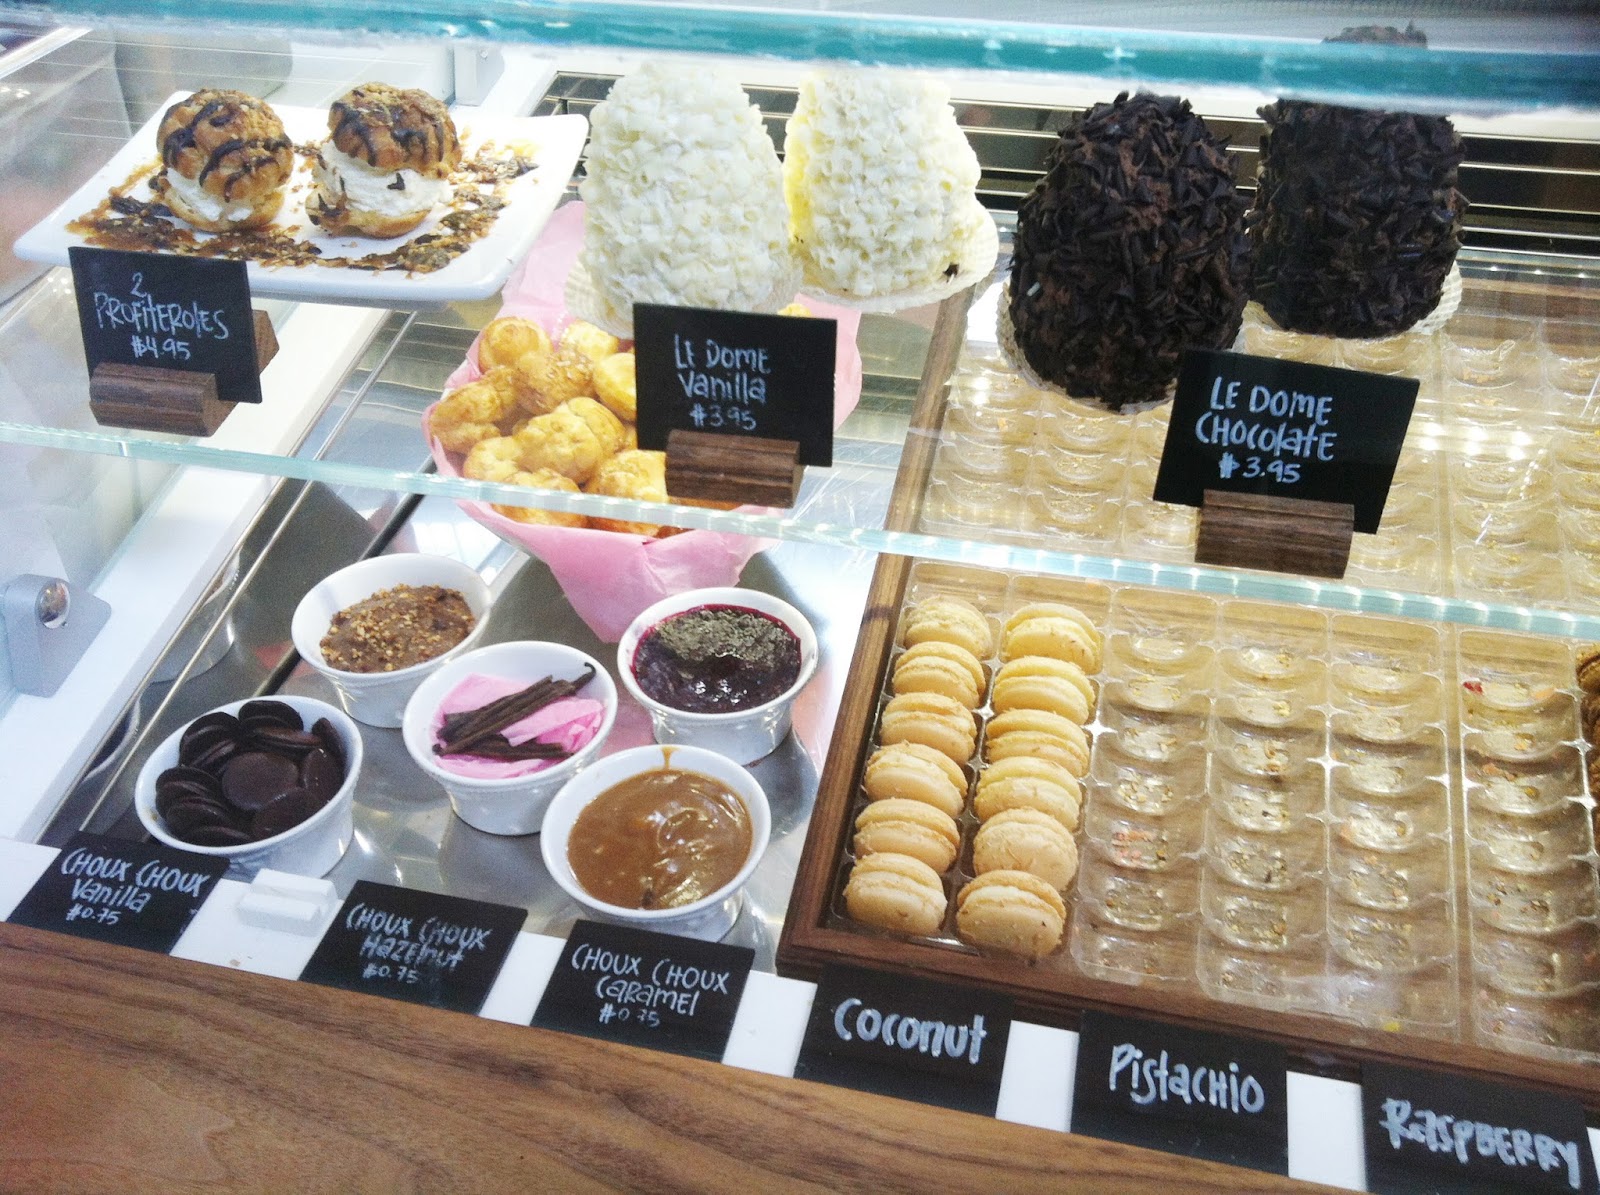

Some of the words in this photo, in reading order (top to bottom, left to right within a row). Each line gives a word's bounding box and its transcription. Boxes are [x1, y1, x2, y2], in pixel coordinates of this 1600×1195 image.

[678, 370, 767, 404] Vanilla
[1210, 376, 1241, 410] LE
[1218, 452, 1301, 483] $3.95
[61, 848, 132, 882] CHOUX
[136, 859, 210, 897] CHOUX
[71, 878, 151, 913] Vanilla
[346, 903, 413, 938] CHOUX
[418, 916, 492, 951] CHOUX
[571, 943, 642, 976] CHOUX
[652, 958, 730, 995] CHOUX
[599, 1003, 661, 1027] $075
